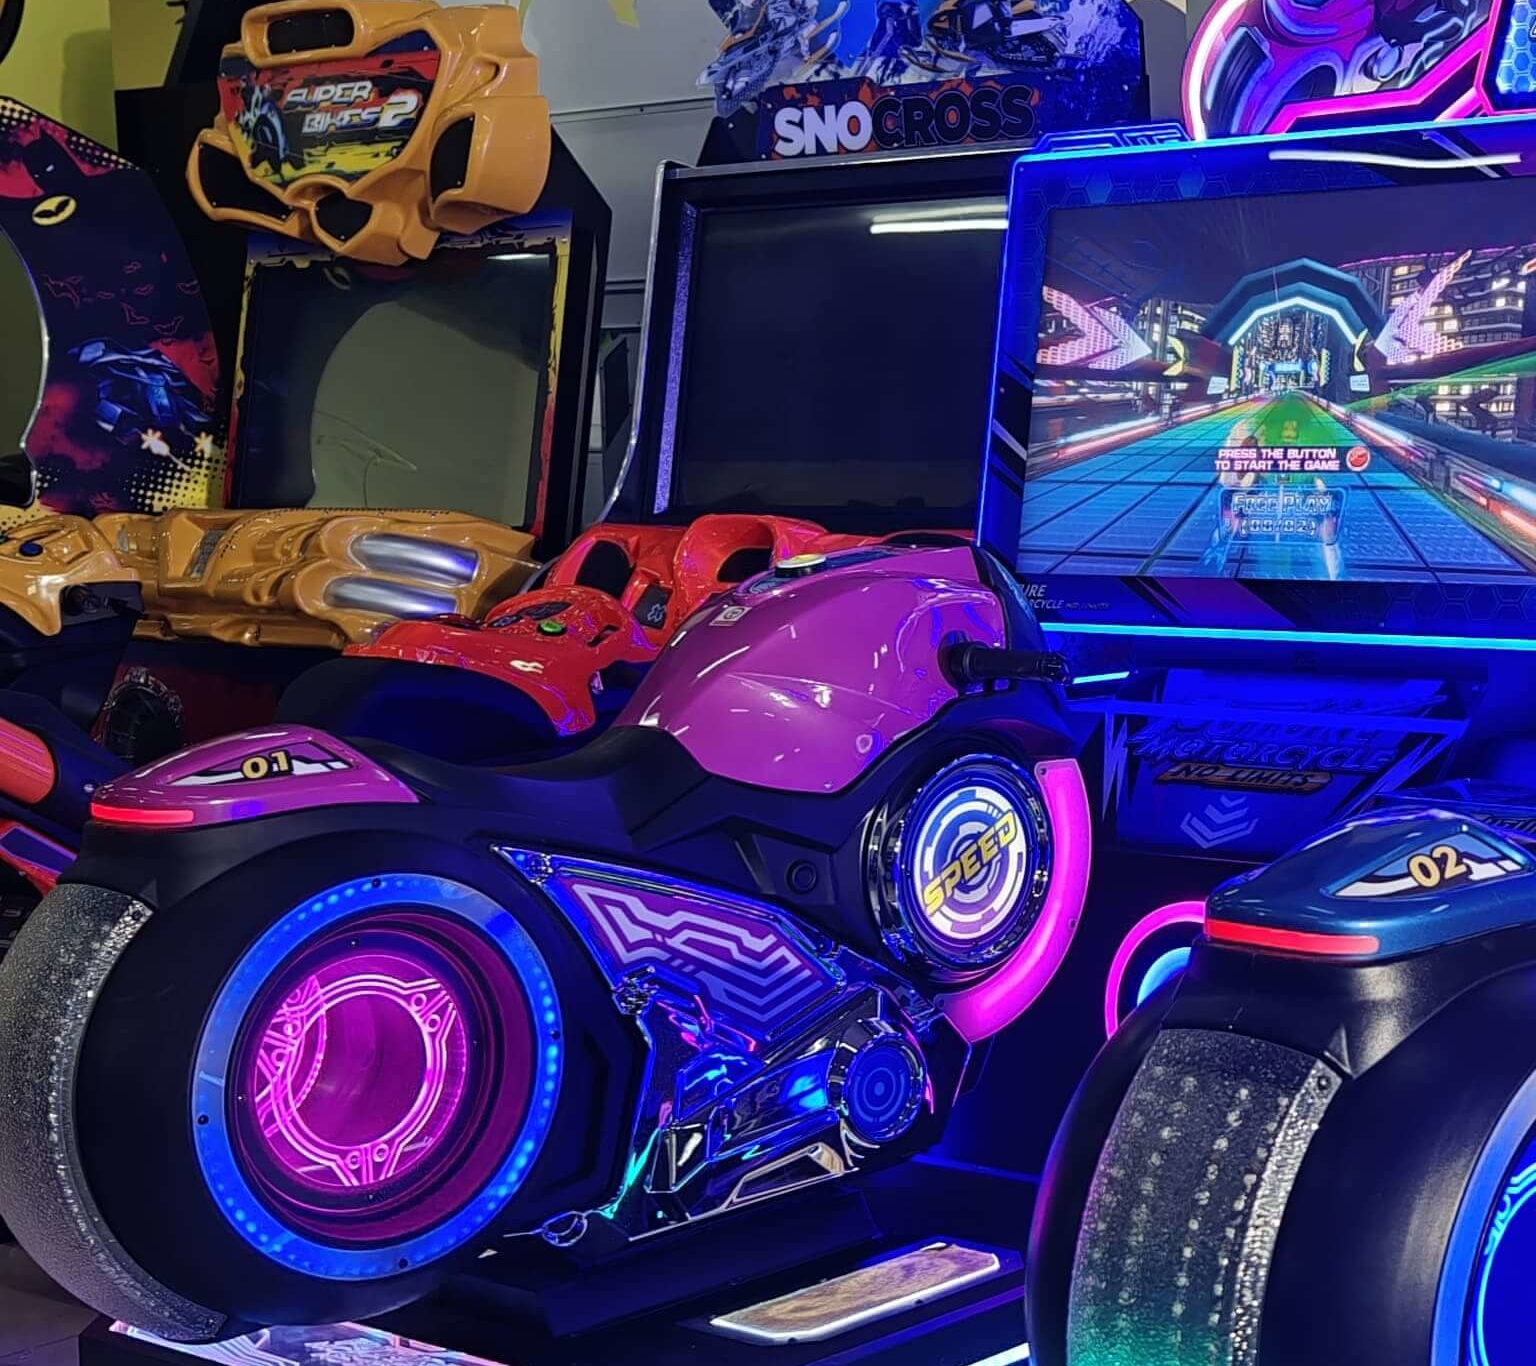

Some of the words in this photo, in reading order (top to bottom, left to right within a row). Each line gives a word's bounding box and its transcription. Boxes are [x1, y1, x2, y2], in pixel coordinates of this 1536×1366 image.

[286, 80, 373, 104] SUPER
[302, 107, 382, 133] BIKES
[774, 84, 1037, 157] SNOCROSS
[1214, 460, 1229, 471] TO
[1233, 460, 1274, 471] START
[1278, 460, 1300, 471] THE
[1304, 460, 1340, 471] GAME
[1218, 448, 1257, 459] PRESS
[1261, 448, 1284, 459] THE
[1287, 448, 1336, 459] BUTTON
[241, 750, 291, 780] 01
[922, 810, 1018, 917] SPEED
[1406, 844, 1469, 888] 02
